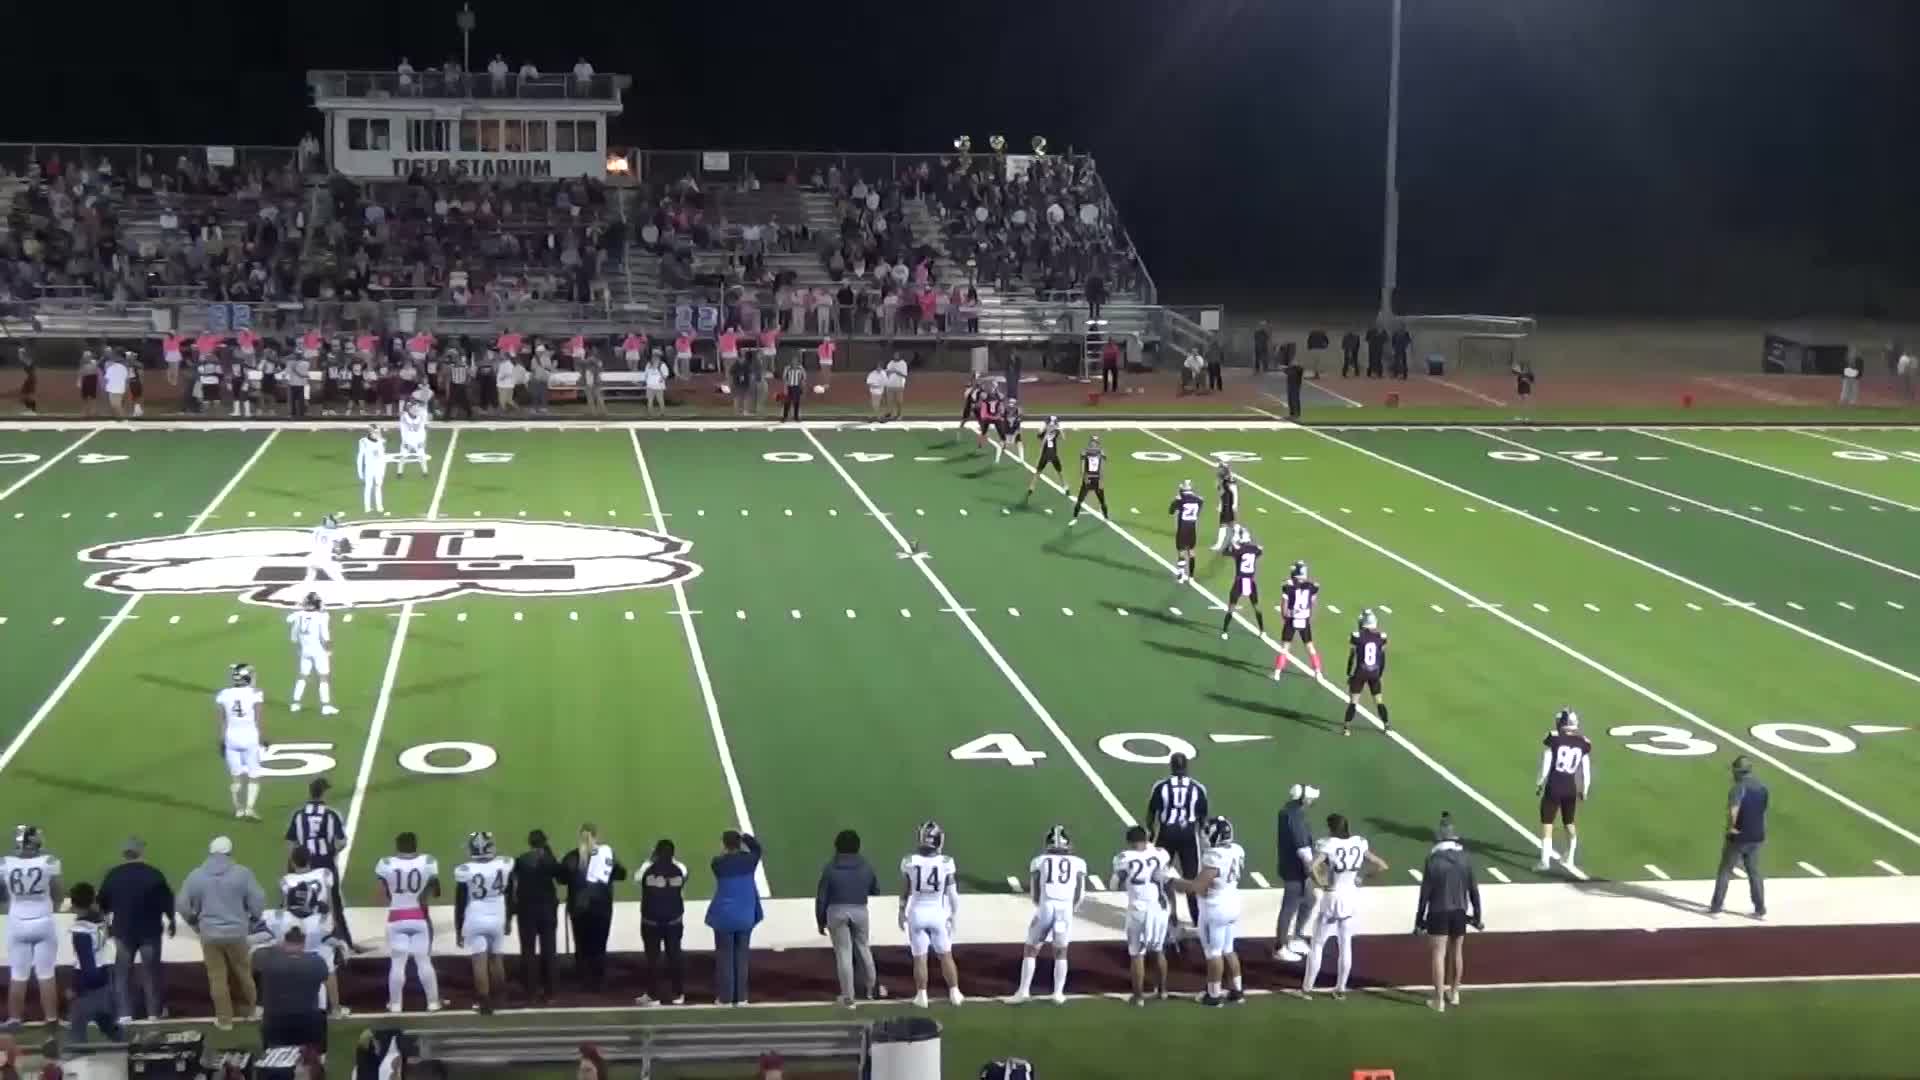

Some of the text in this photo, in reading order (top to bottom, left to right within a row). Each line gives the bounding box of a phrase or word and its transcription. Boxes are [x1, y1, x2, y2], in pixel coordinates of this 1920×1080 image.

[1364, 642, 1377, 666] 8
[232, 700, 247, 717] 4
[1555, 744, 1582, 774] 80
[1045, 857, 1071, 884] 19
[1334, 846, 1360, 873] 32
[10, 868, 44, 896] 62
[394, 868, 421, 894] 10
[472, 869, 507, 899] 34
[914, 865, 940, 892] 14
